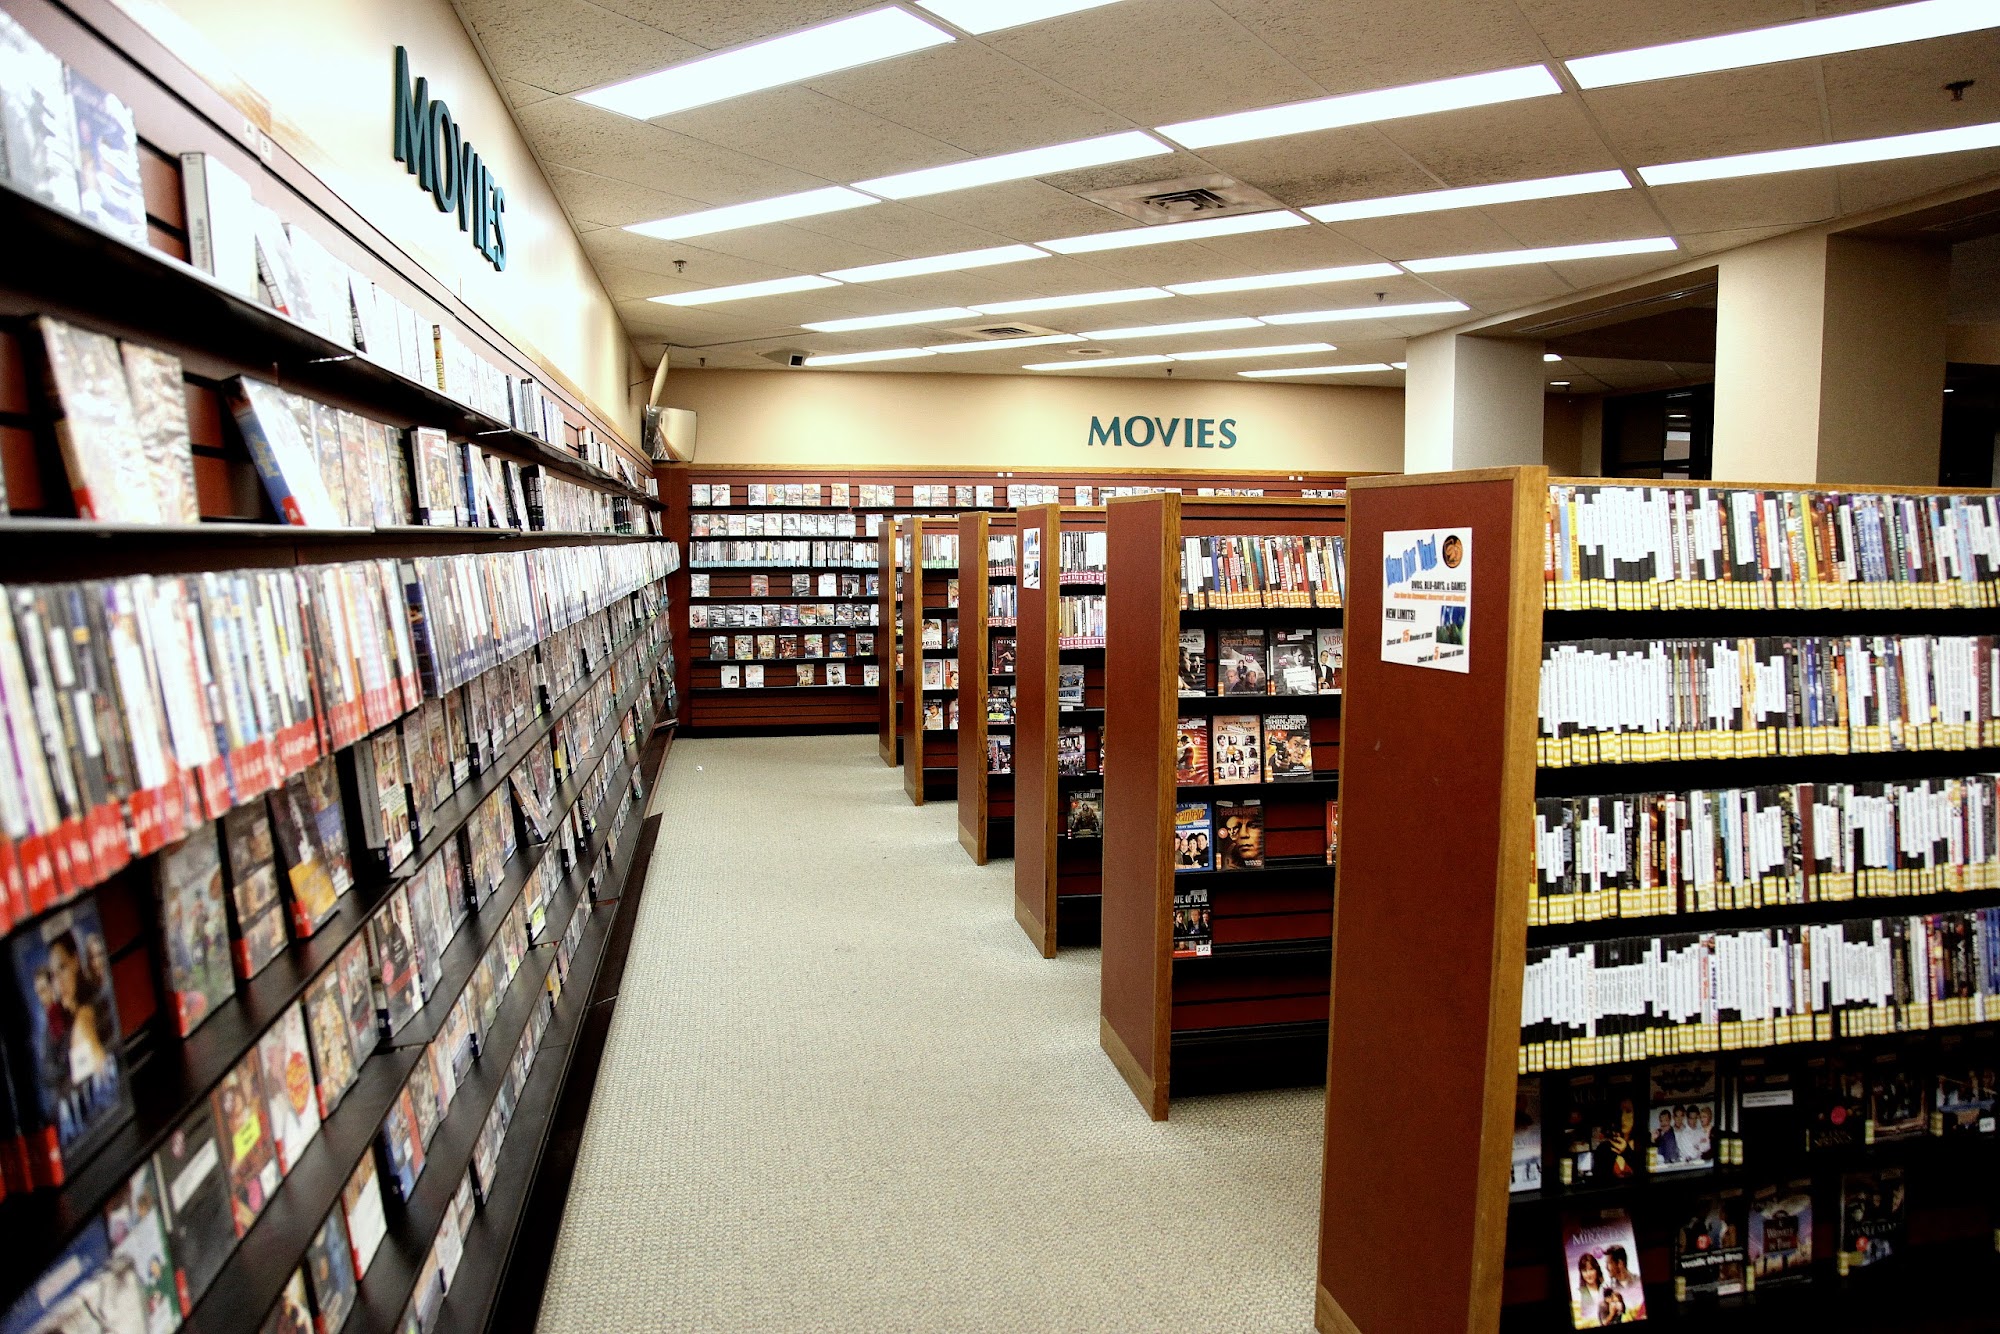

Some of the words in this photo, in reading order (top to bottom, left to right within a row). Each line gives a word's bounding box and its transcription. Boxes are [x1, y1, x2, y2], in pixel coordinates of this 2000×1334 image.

[394, 45, 507, 272] MOVIES
[353, 318, 364, 344] BEAVER
[1087, 415, 1237, 449] MOVIES
[1451, 581, 1467, 591] GAMES
[1385, 608, 1396, 619] NEW
[1323, 635, 1343, 645] SABR
[1980, 661, 1989, 689] WEST
[1174, 894, 1185, 904] ATE
[1185, 894, 1193, 903] OF
[1681, 1258, 1707, 1269] walk
[1707, 1255, 1724, 1265] the
[1724, 1252, 1743, 1262] line
